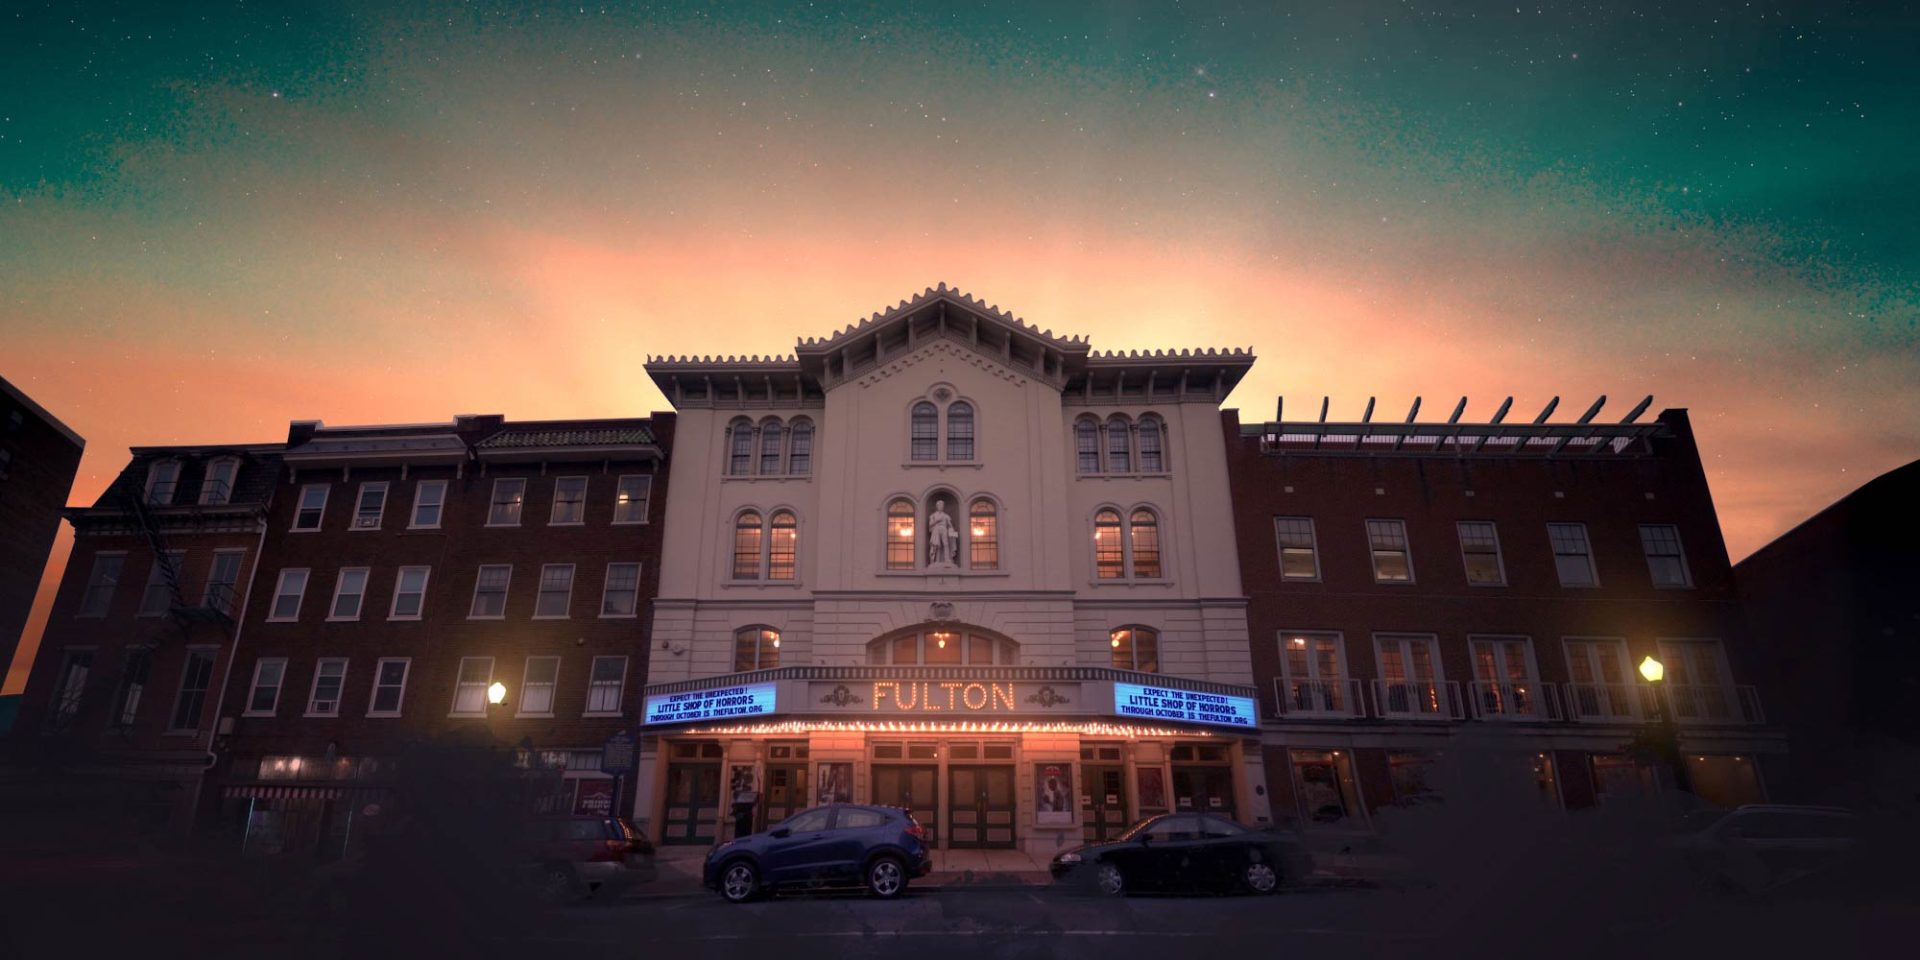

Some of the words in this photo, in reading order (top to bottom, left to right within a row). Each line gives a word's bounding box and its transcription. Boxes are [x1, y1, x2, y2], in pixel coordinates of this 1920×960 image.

[669, 693, 690, 702] EXPECT
[693, 692, 703, 700] THE
[705, 687, 748, 698] UNEXPECTED!
[873, 682, 1015, 711] FULTON
[1143, 688, 1168, 697] EXPECT
[1171, 691, 1184, 699] THE
[1185, 692, 1228, 704] UNEXPECTED!
[657, 703, 681, 713] LITTLE
[683, 700, 702, 711] SHOP
[703, 699, 714, 709] OF
[716, 695, 754, 708] HORRORS
[1129, 695, 1159, 707] LITTLE
[1161, 698, 1184, 710] SHOP
[1186, 701, 1197, 711] OF
[1199, 702, 1236, 715] HORRORS
[650, 713, 674, 722] THROUGH
[676, 711, 702, 720] OCTOBER
[713, 705, 763, 716] THEFULTON.ORG
[1121, 705, 1154, 716] THROUGH
[1155, 708, 1185, 719] OCTOBER
[1198, 713, 1248, 725] THEFULTON.ORG
